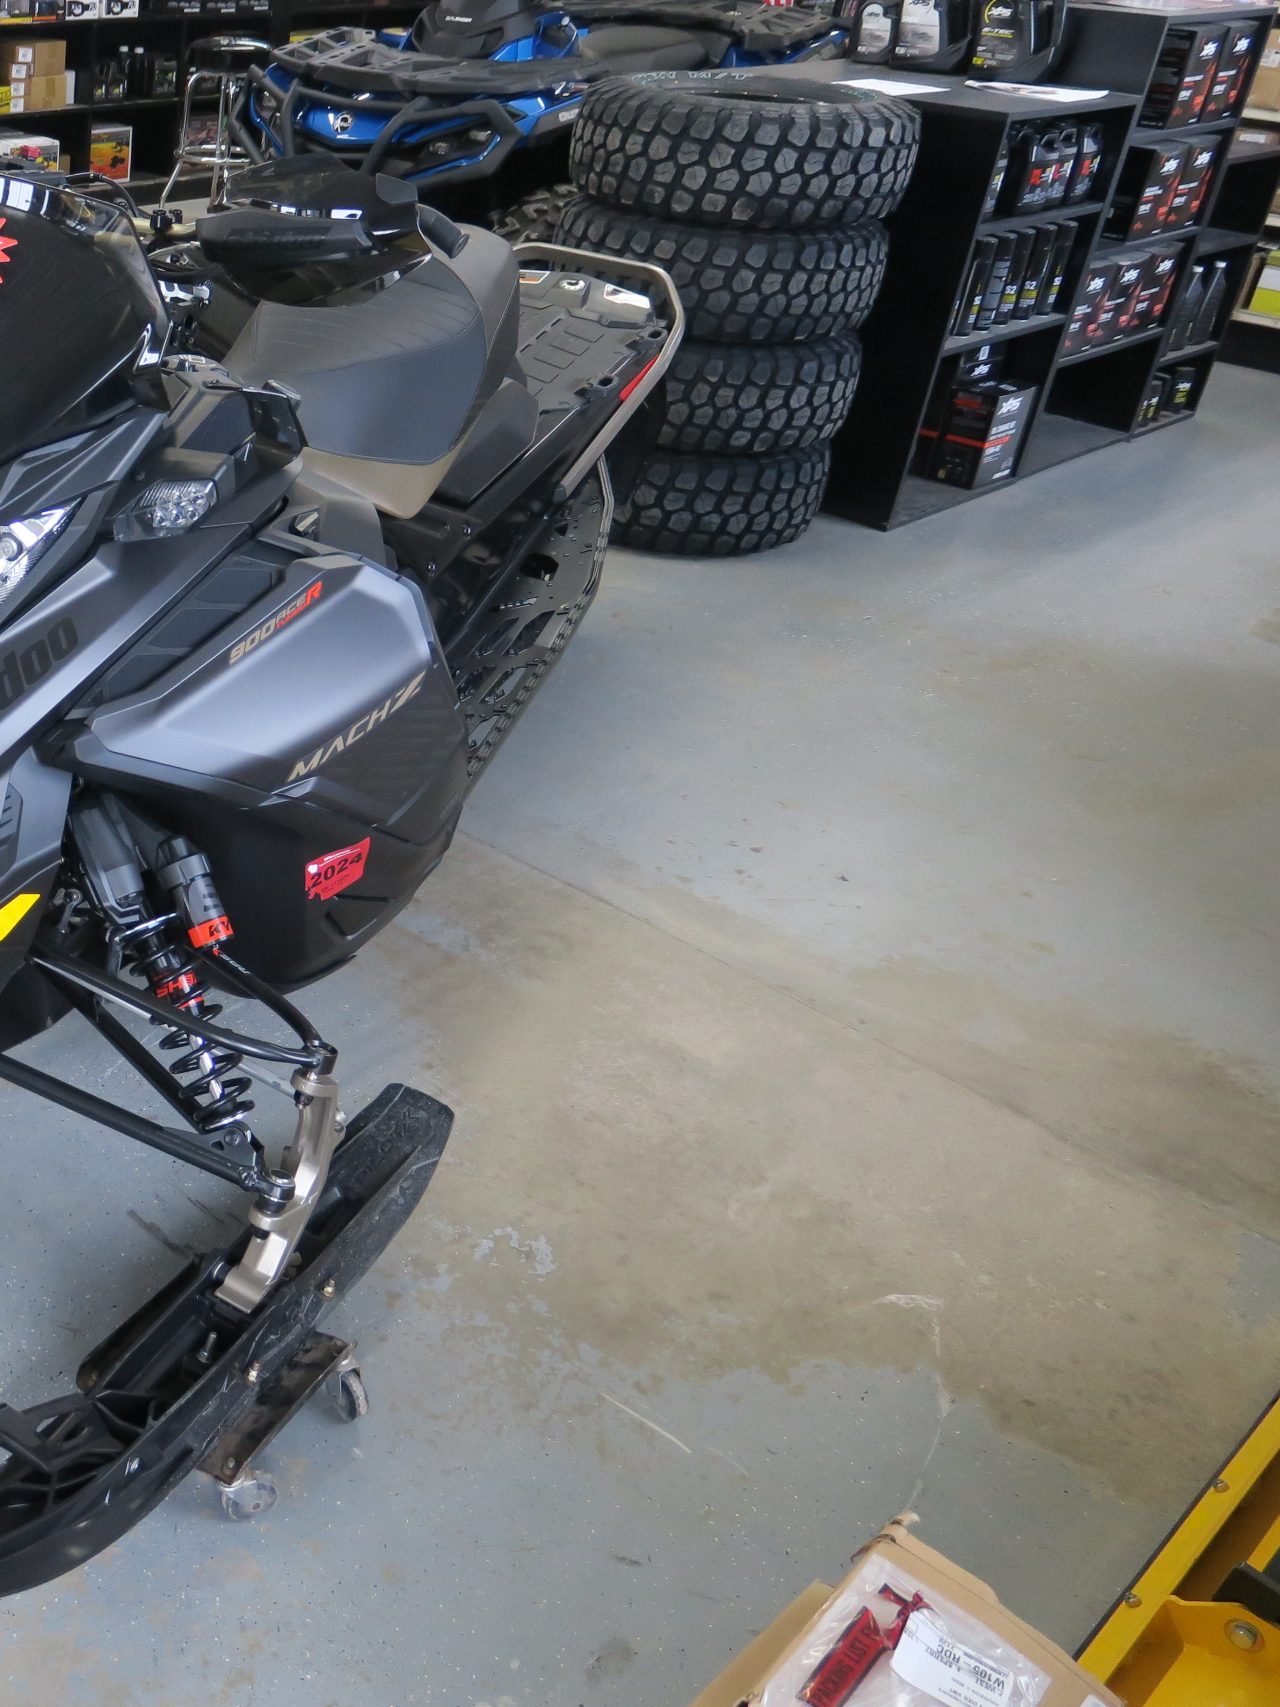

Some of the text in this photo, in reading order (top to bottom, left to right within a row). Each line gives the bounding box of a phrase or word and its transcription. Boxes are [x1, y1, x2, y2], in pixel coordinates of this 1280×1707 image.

[287, 699, 392, 782] MACH
[310, 852, 362, 888] 2024
[843, 1637, 870, 1664] LIST
[936, 1644, 961, 1664] RDC
[972, 1664, 1006, 1690] W105
